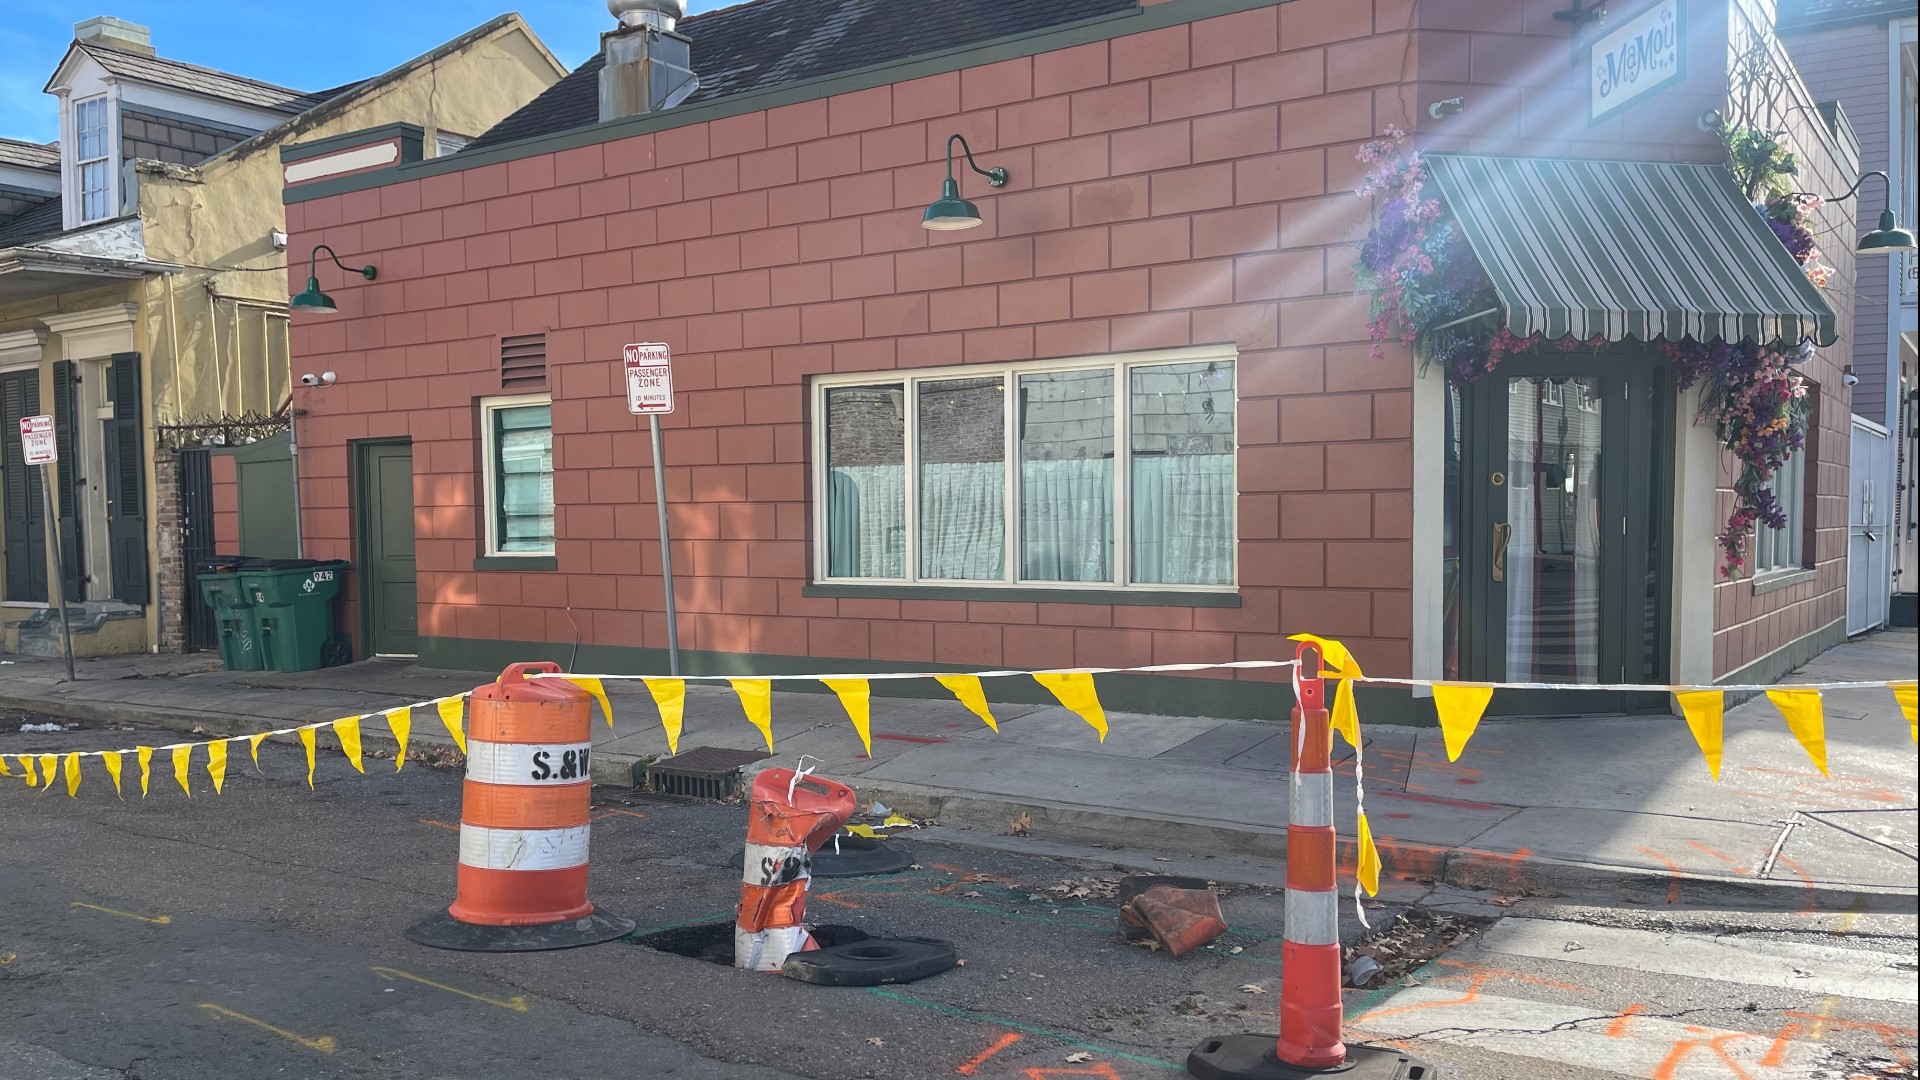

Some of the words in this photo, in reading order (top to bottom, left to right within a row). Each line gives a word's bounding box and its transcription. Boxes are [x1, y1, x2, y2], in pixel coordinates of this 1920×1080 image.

[626, 349, 639, 363] NO
[639, 350, 667, 361] PARKING
[629, 368, 667, 378] PASSENGER
[638, 378, 661, 388] ZONE
[22, 421, 31, 430] NO
[314, 571, 333, 582] 942
